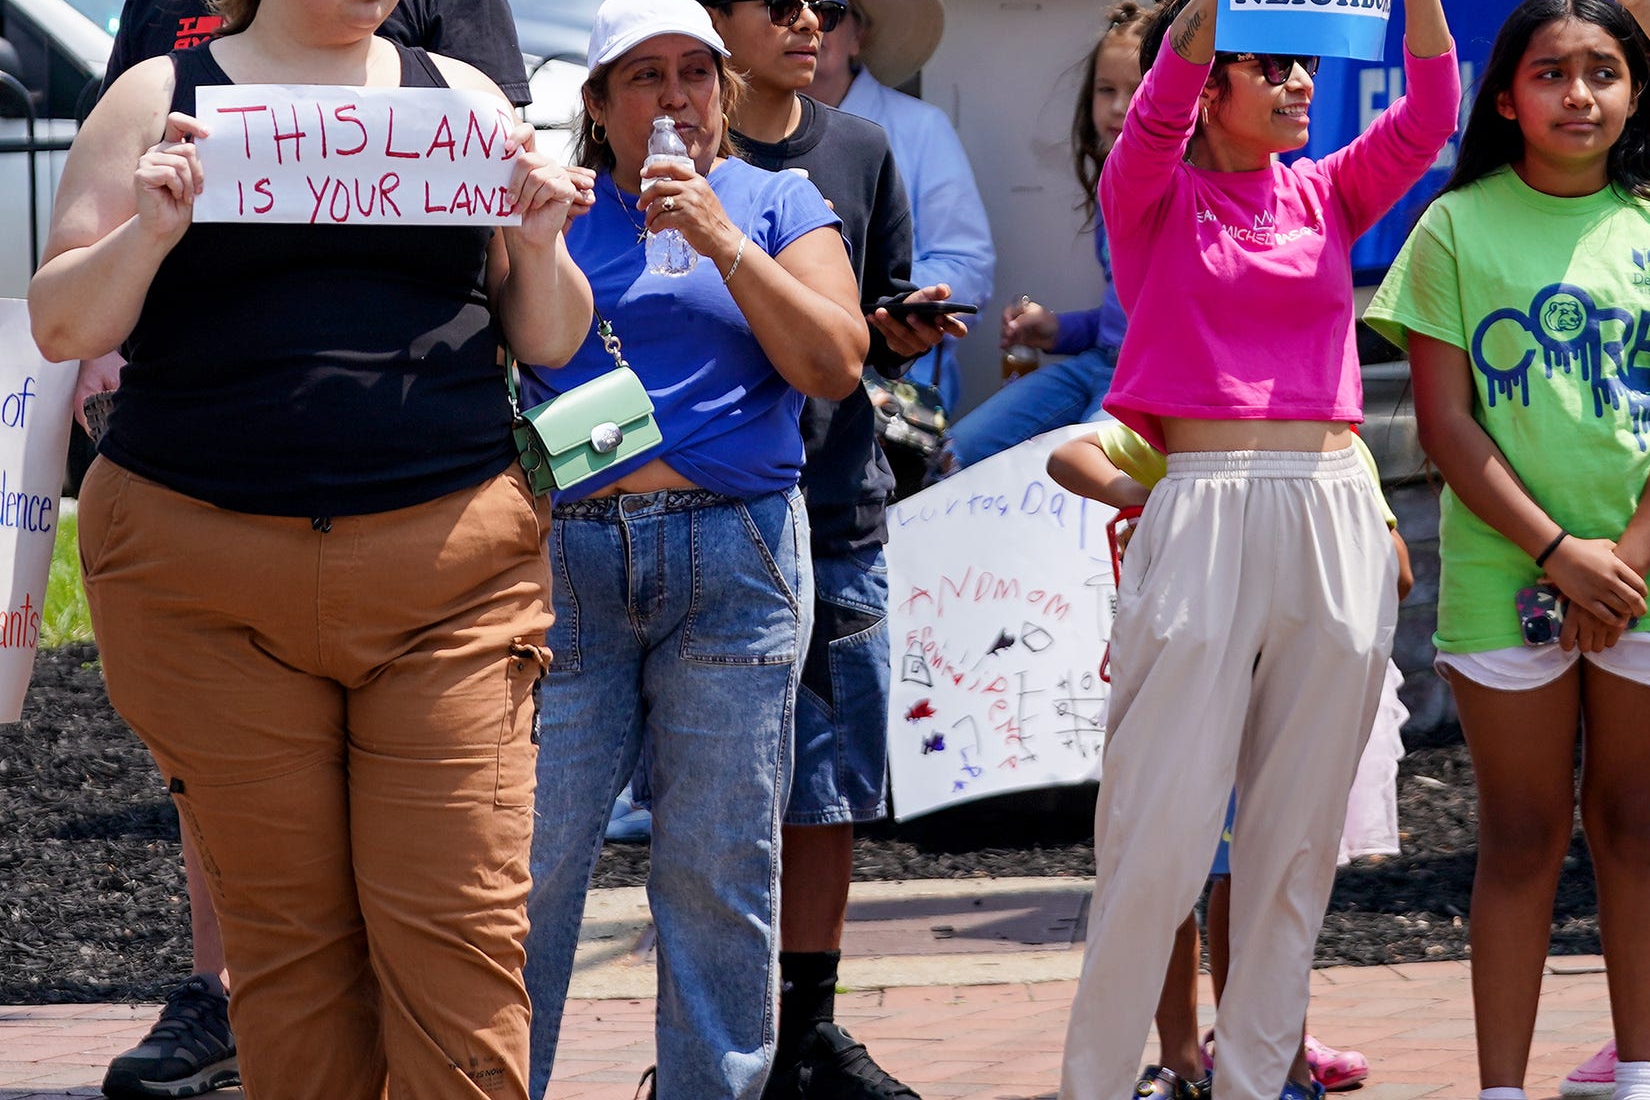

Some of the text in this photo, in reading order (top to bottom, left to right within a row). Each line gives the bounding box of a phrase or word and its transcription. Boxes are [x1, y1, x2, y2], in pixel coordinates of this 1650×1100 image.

[217, 104, 368, 164] THIS
[238, 178, 274, 216] IS
[307, 172, 402, 224] YOUR
[2, 377, 36, 428] of
